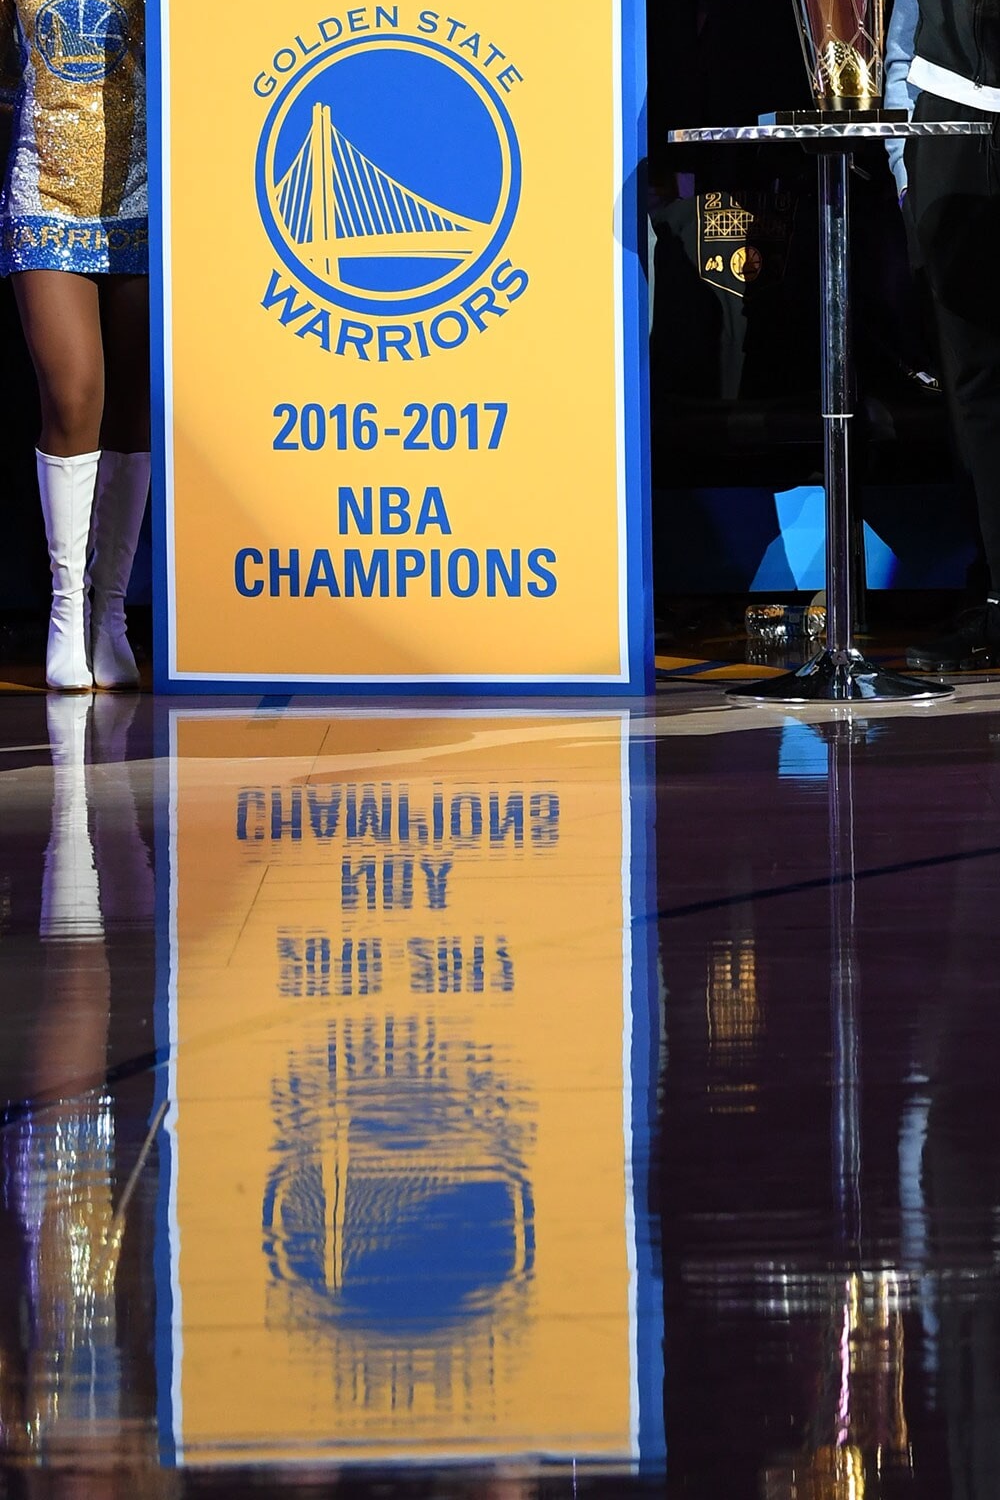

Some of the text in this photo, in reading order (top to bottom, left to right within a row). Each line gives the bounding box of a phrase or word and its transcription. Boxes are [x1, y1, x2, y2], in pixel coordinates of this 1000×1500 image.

[253, 5, 523, 98] GOLDEN STATE
[261, 259, 529, 363] WARRIORS
[272, 401, 509, 451] 2016-2017
[337, 485, 452, 535] NBA
[234, 547, 558, 599] CHAMPIONS
